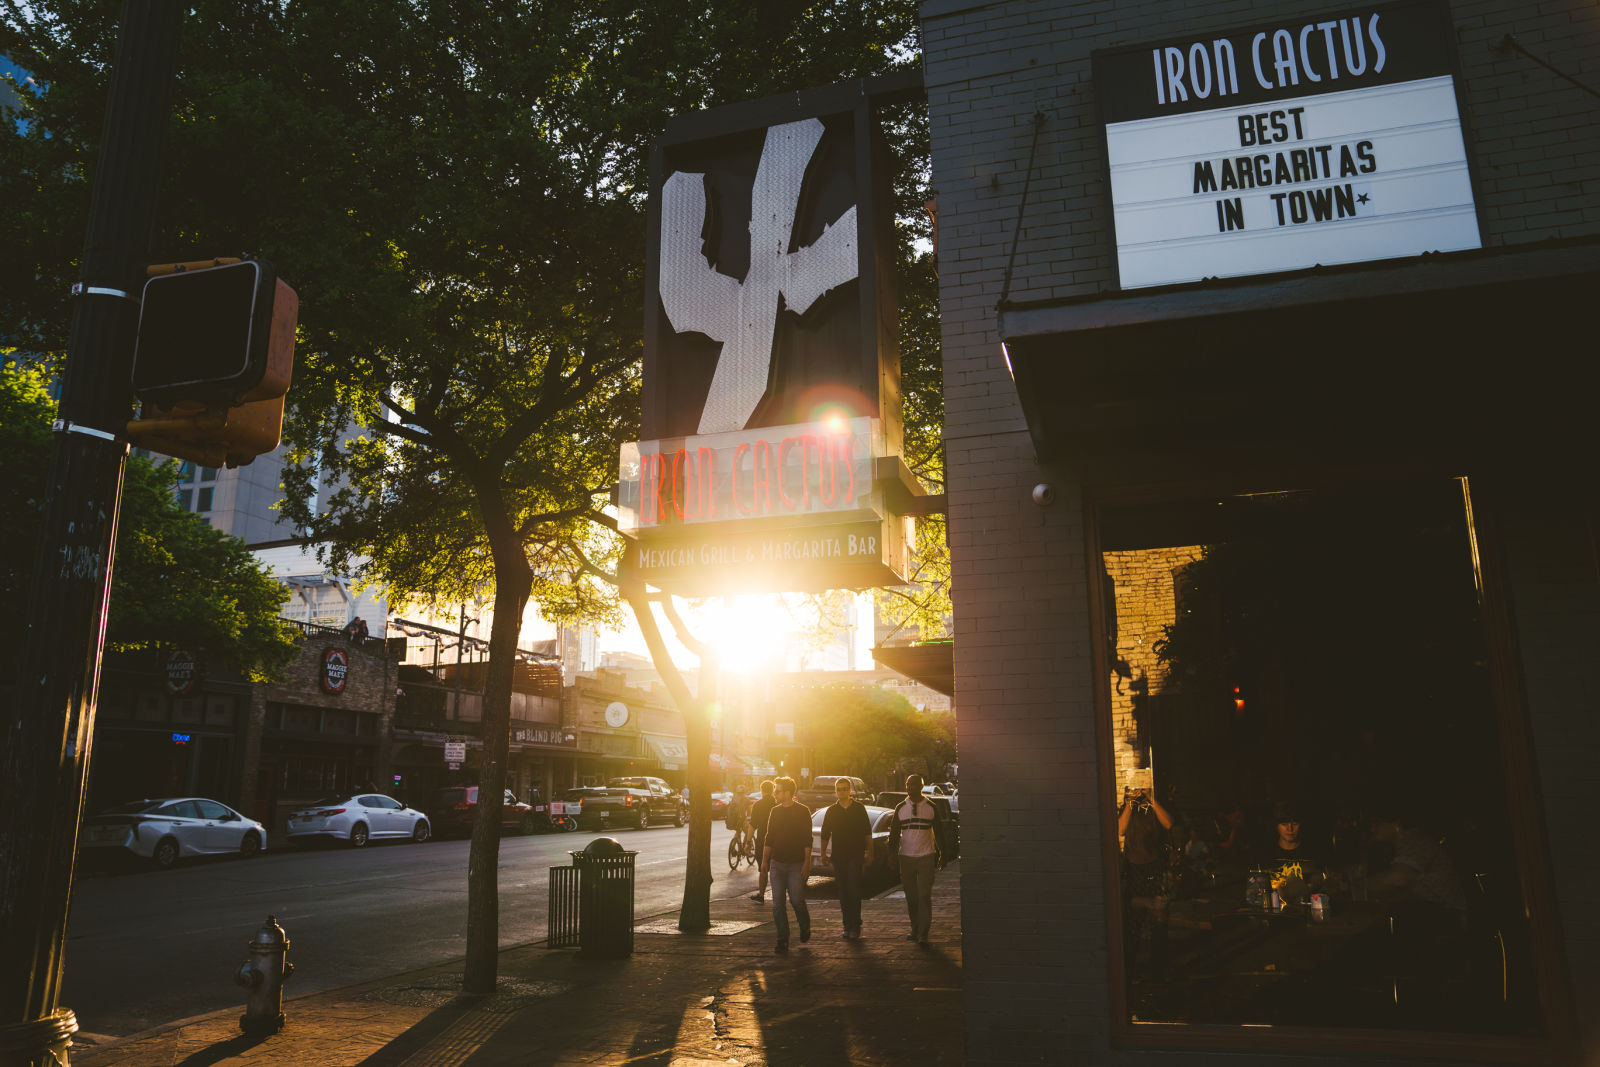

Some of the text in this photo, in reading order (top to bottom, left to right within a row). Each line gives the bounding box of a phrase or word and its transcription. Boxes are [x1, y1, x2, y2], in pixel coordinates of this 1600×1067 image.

[1152, 13, 1387, 105] IRON CACTUS
[1238, 107, 1305, 147] BEST
[1193, 141, 1377, 194] MARGARITAS
[1216, 197, 1245, 233] IN
[639, 432, 855, 522] IRON CACTUS
[848, 534, 876, 556] BAR
[526, 729, 548, 743] BLIND
[550, 731, 562, 744] PIG
